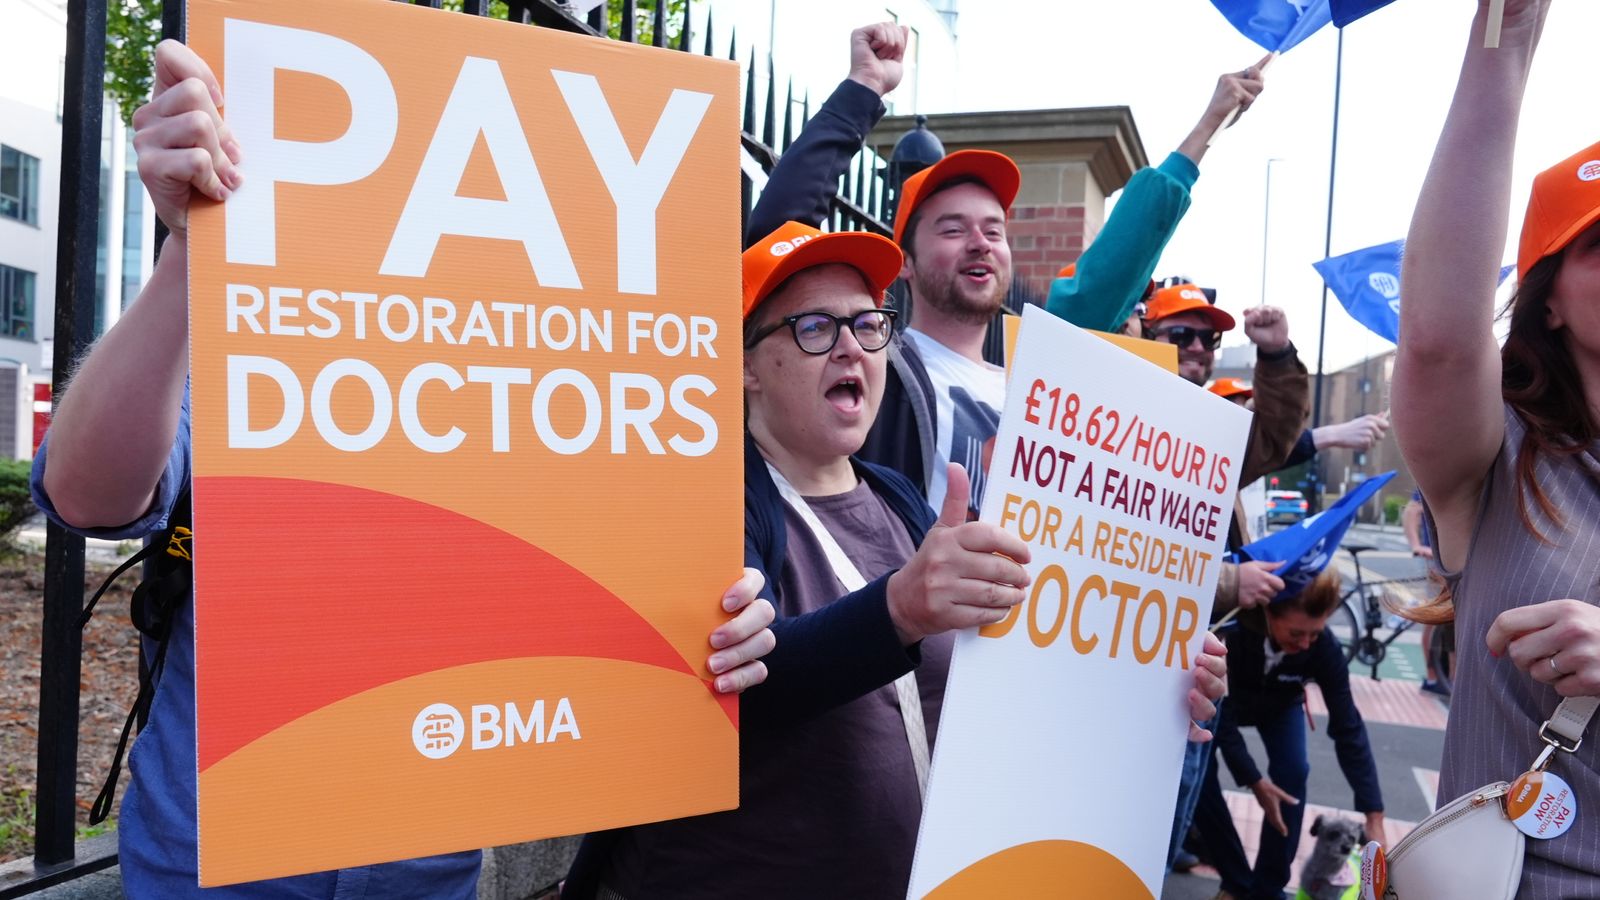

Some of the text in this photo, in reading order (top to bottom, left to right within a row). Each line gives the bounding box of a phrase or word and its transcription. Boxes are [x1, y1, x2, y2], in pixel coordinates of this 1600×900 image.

[224, 18, 714, 295] PAY
[226, 283, 718, 358] RESTORATION FOR
[227, 354, 718, 456] DOCTORS
[1024, 379, 1231, 495] £18.62/HOUR IS
[1010, 436, 1076, 492] NOT
[1074, 461, 1094, 503] A
[1100, 468, 1156, 521] FAIR
[1159, 487, 1221, 542] WAGE
[1000, 493, 1062, 548] FOR
[1064, 515, 1084, 556] A
[1091, 521, 1212, 587] RESIDENT
[472, 697, 581, 750] BMA
[1534, 793, 1556, 821] NOW
[1537, 788, 1569, 836] RESTORATION
[1553, 806, 1570, 829] PAY
